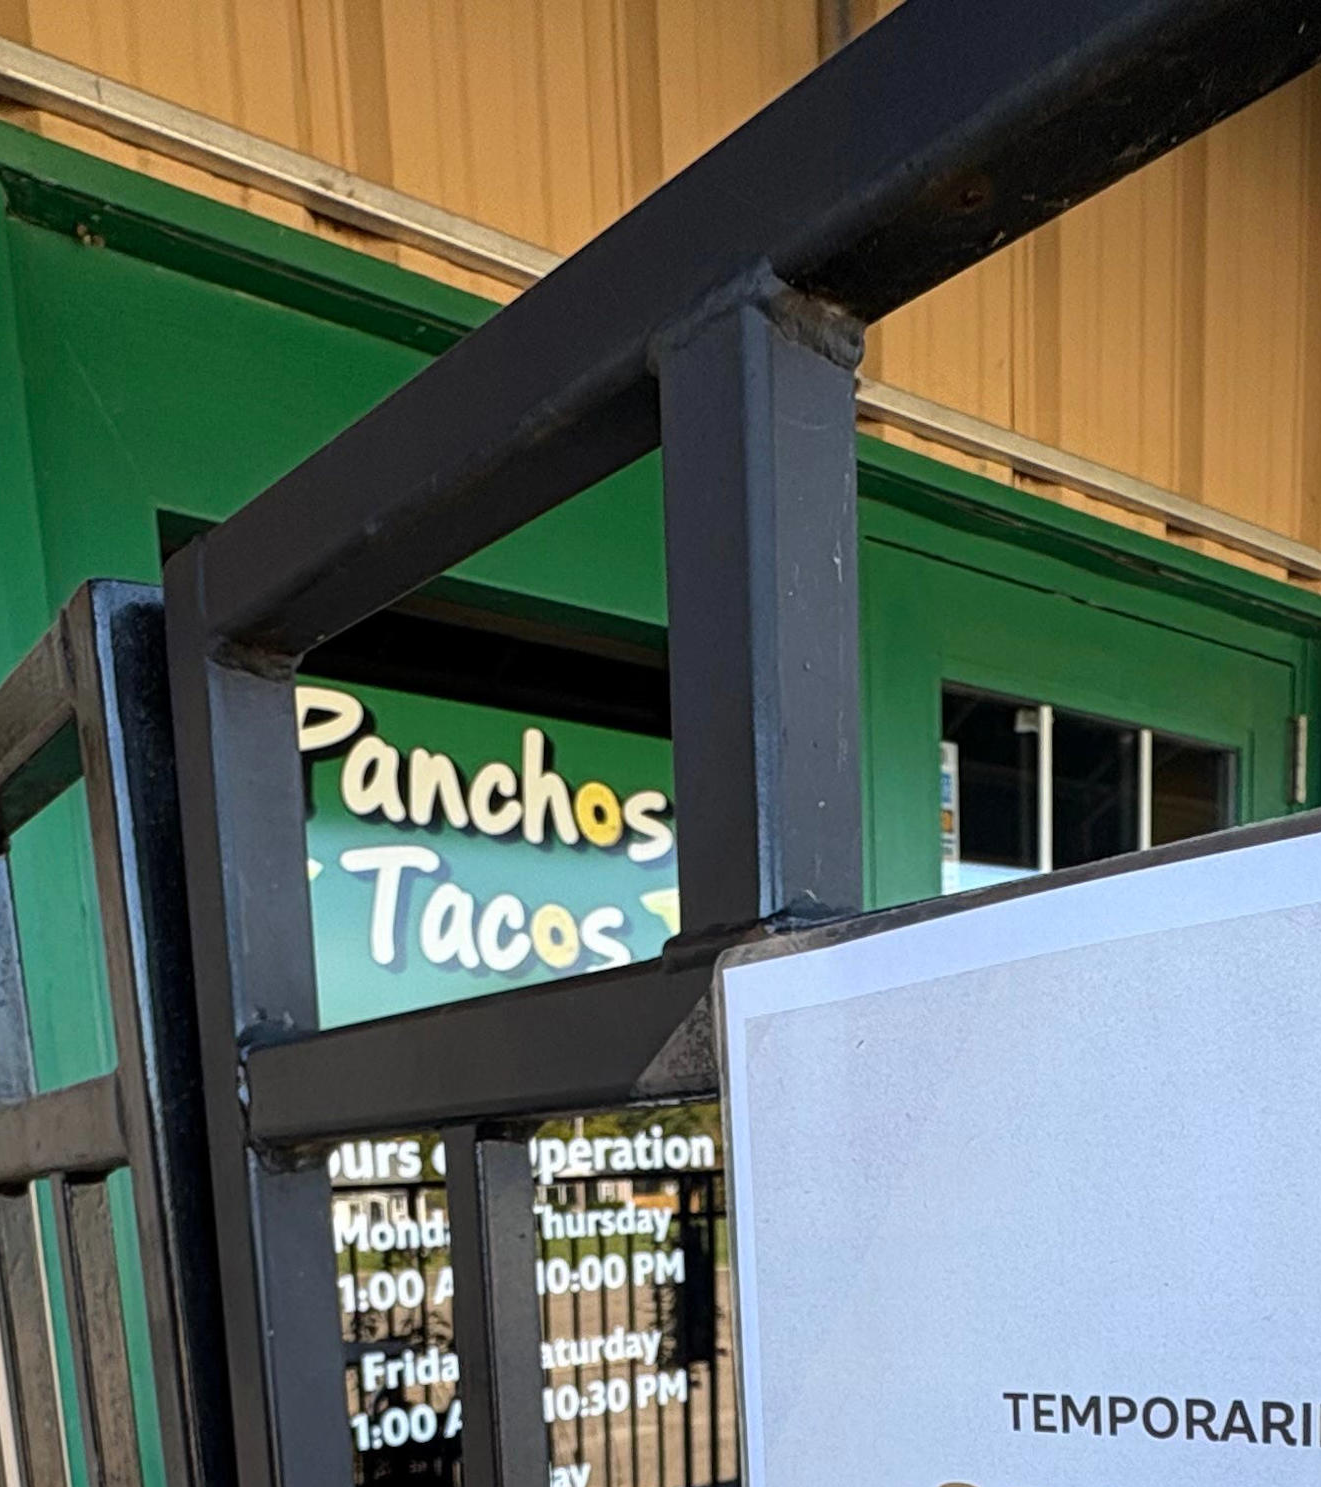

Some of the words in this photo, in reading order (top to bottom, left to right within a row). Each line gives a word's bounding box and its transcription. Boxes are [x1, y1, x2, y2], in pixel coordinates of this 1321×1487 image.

[294, 685, 673, 862] Panchos
[339, 845, 632, 972] Tacos
[332, 1200, 451, 1254] Mond
[632, 1248, 686, 1287] PM
[361, 1345, 460, 1393] Frida
[541, 1327, 662, 1370] aturday
[542, 1377, 630, 1423] 10:30
[635, 1368, 687, 1410] PM
